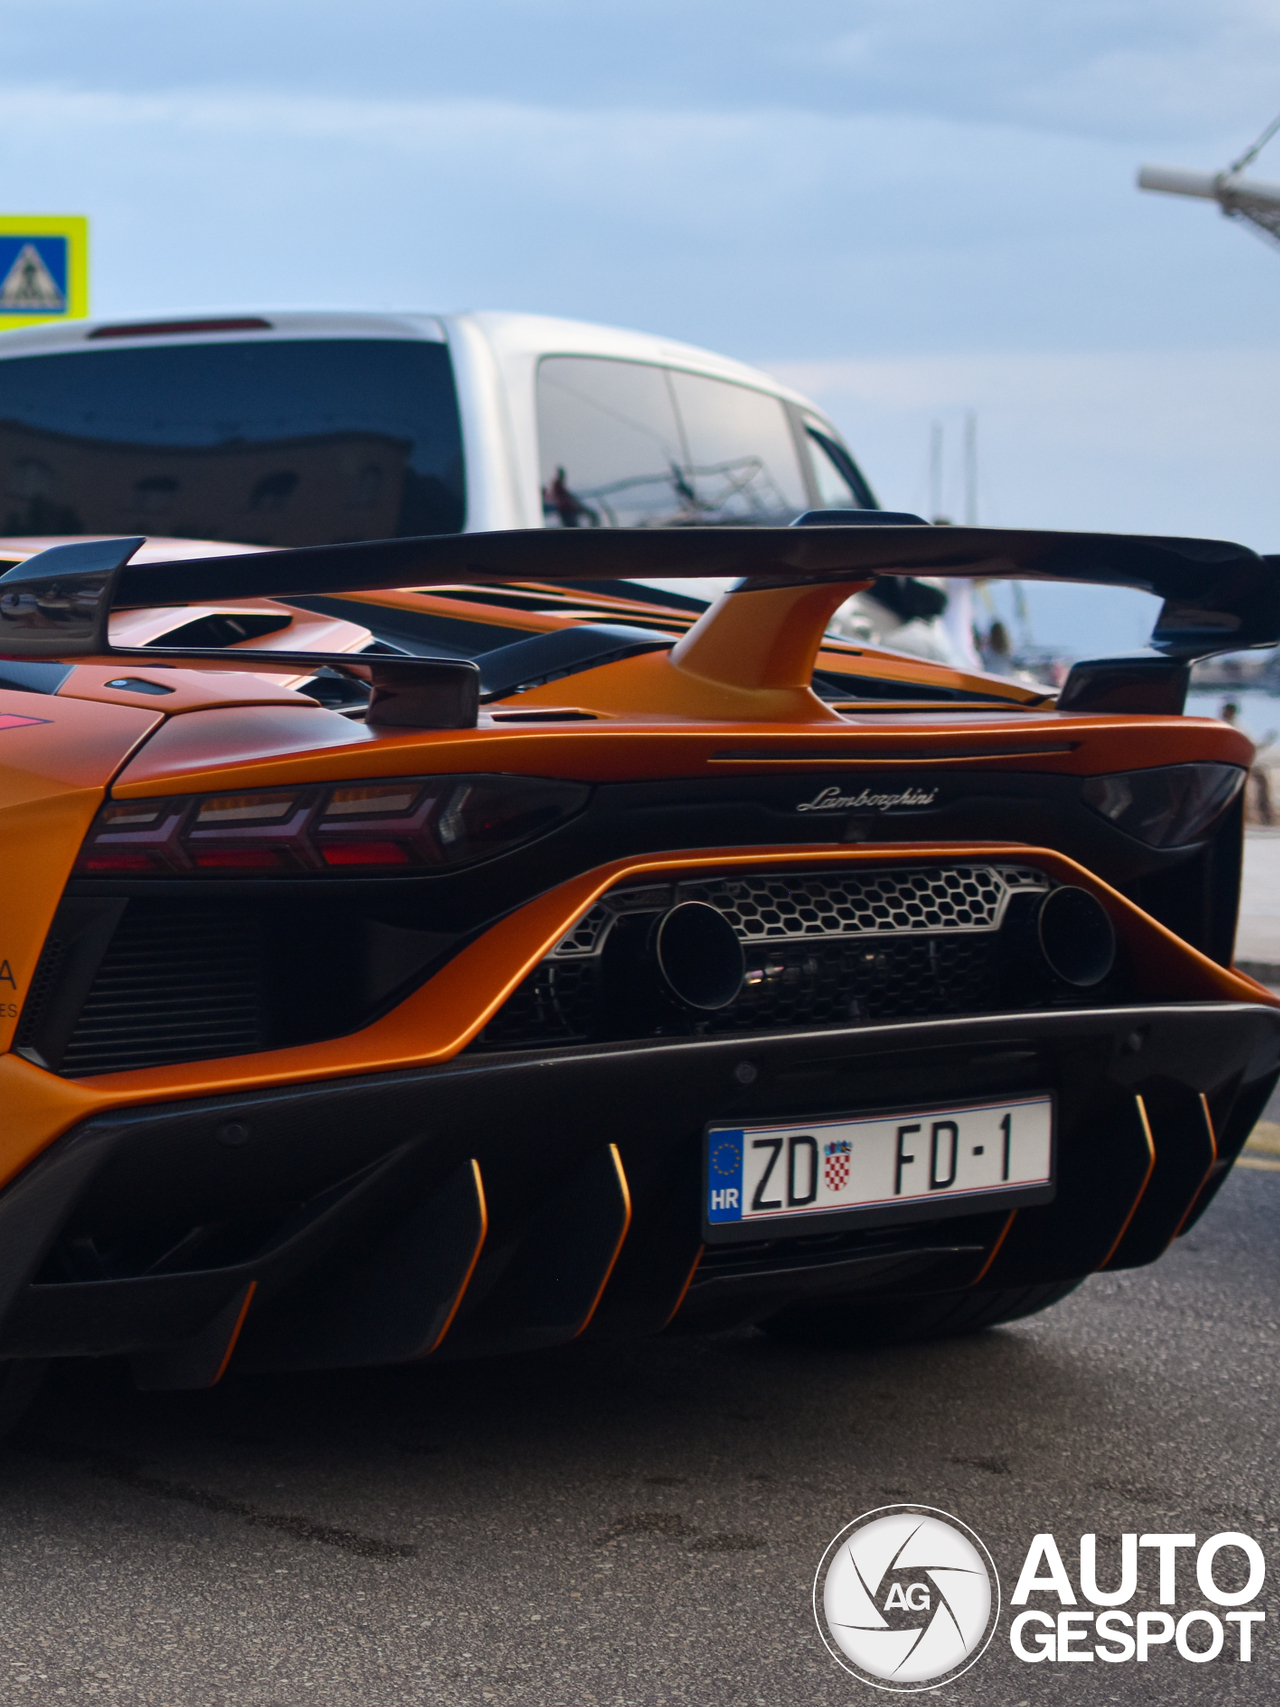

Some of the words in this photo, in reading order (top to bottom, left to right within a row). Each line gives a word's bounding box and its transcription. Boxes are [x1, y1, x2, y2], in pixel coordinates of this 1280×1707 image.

[796, 786, 940, 812] Lamborghini
[751, 1135, 819, 1211] ZD
[711, 1187, 740, 1211] HR
